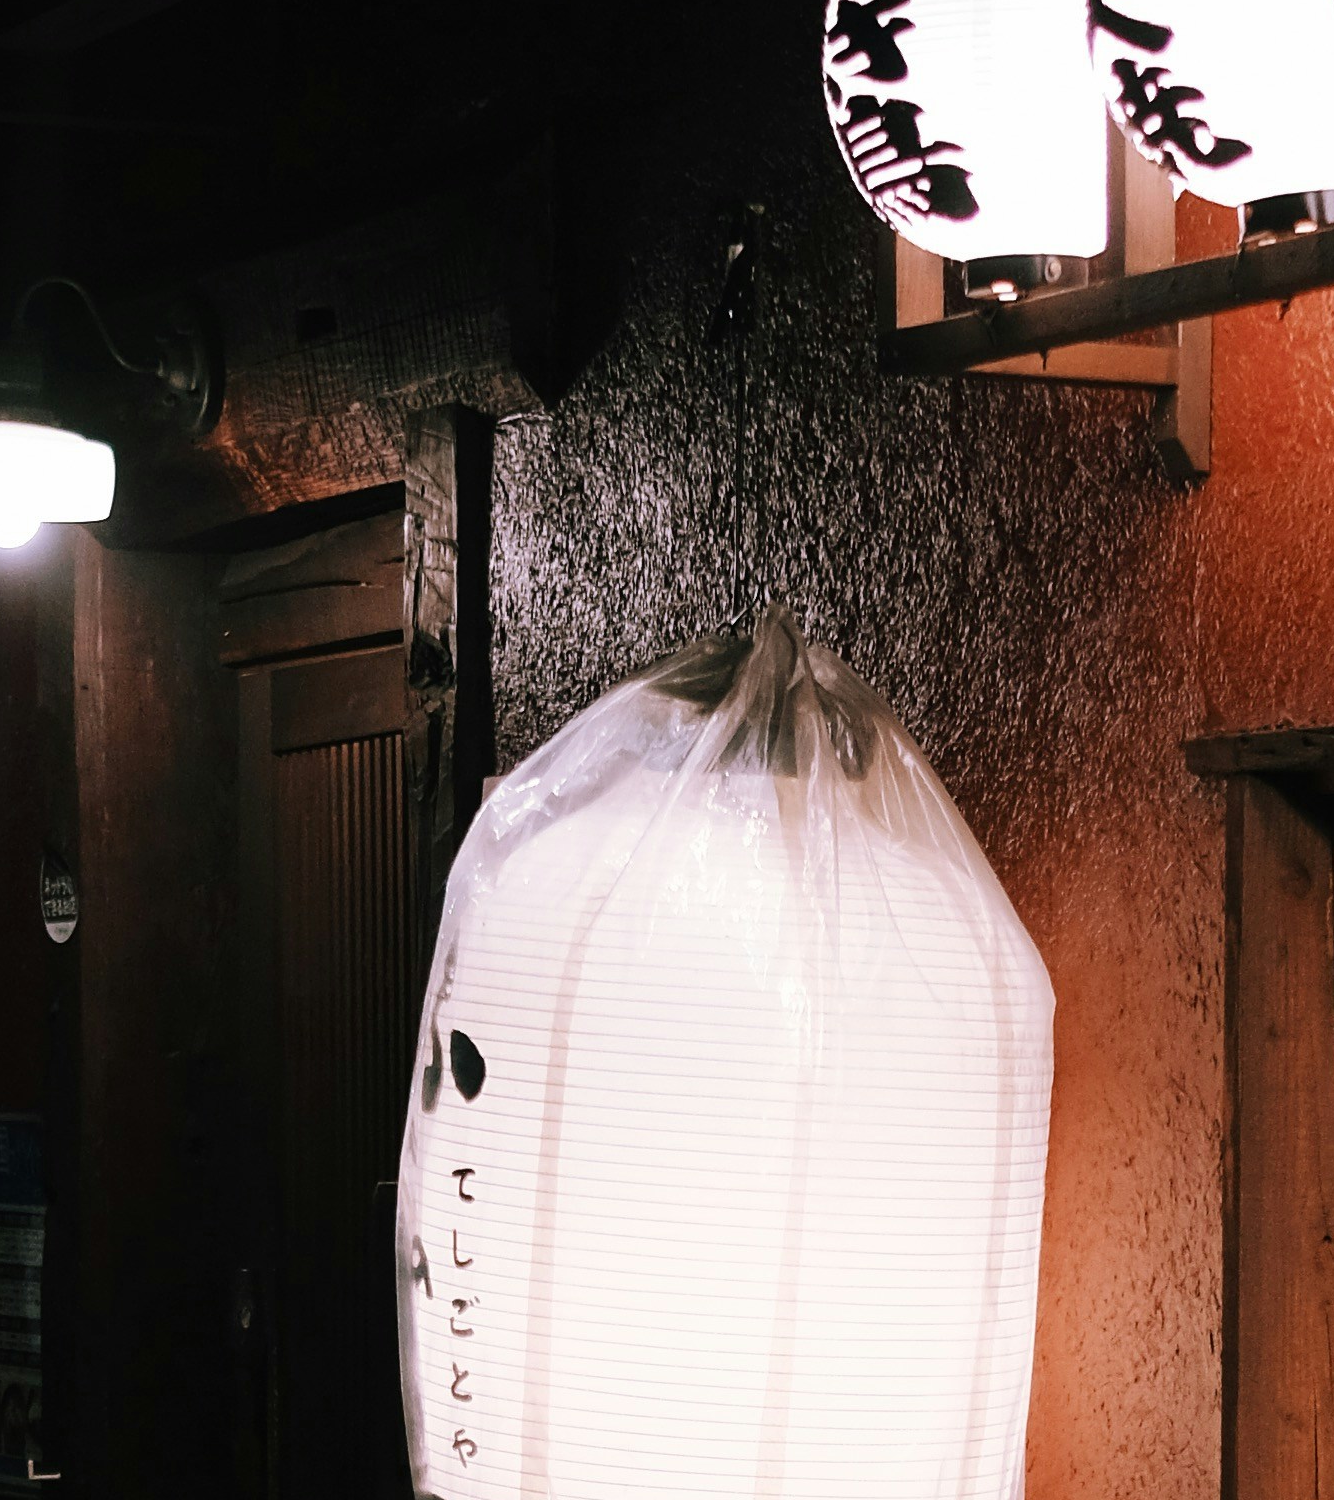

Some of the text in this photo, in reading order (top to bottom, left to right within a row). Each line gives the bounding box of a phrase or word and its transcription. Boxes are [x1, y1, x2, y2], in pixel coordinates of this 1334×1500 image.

[448, 1166, 479, 1469] てしごとや
